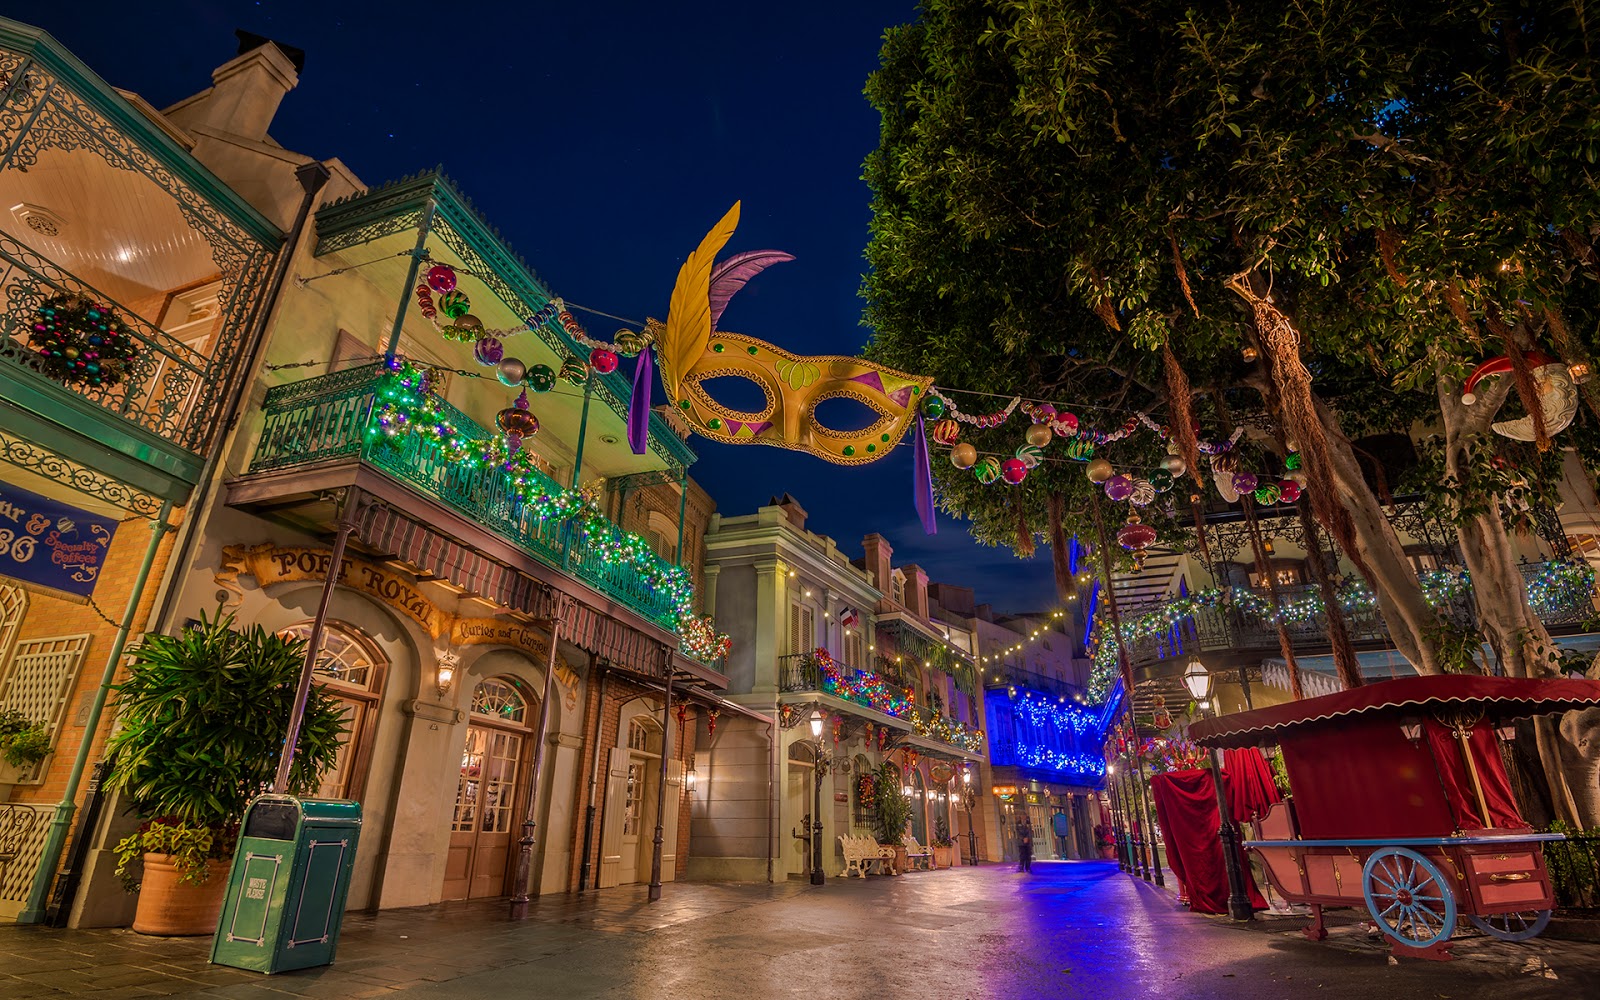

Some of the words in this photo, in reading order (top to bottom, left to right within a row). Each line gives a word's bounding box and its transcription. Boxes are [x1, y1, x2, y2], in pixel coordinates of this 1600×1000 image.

[44, 530, 99, 554] Specialty
[51, 550, 97, 564] Coffees
[362, 567, 433, 628] ROYAL
[460, 622, 494, 639] Curios
[498, 627, 518, 639] and
[249, 878, 267, 889] WASTE
[245, 888, 265, 899] PLEASE
